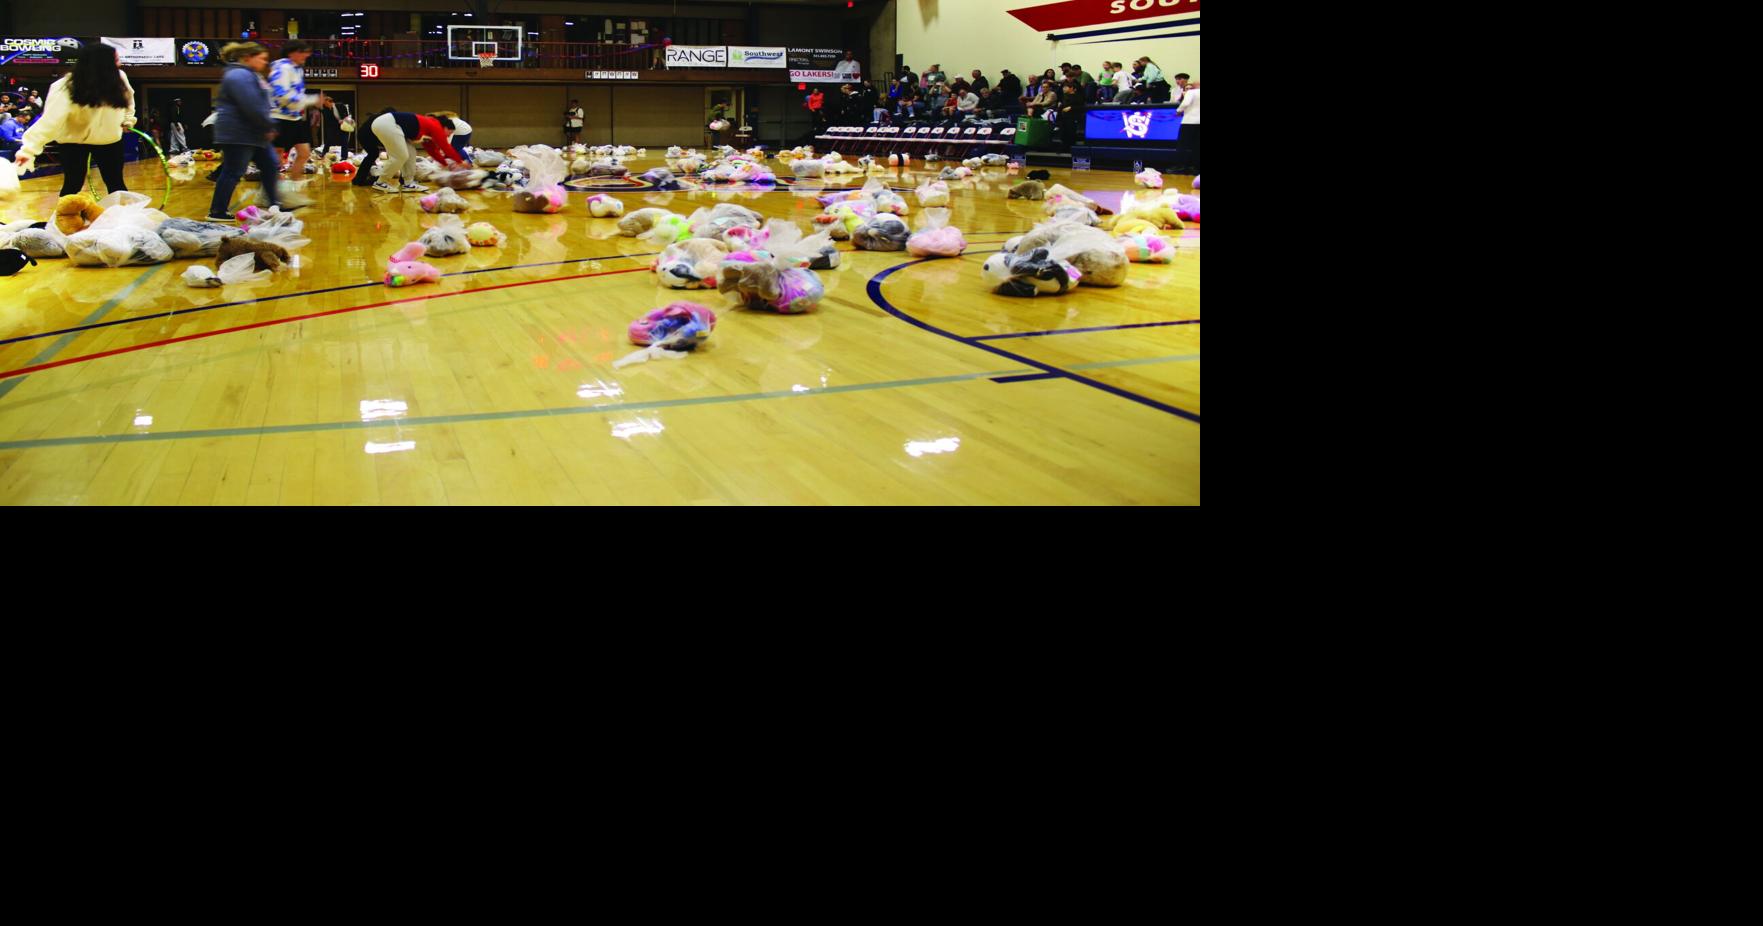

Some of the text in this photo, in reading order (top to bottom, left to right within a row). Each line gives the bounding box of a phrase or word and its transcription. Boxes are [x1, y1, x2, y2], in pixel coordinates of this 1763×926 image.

[1109, 0, 1198, 14] SO
[667, 49, 725, 63] RANGE
[361, 65, 378, 77] 30
